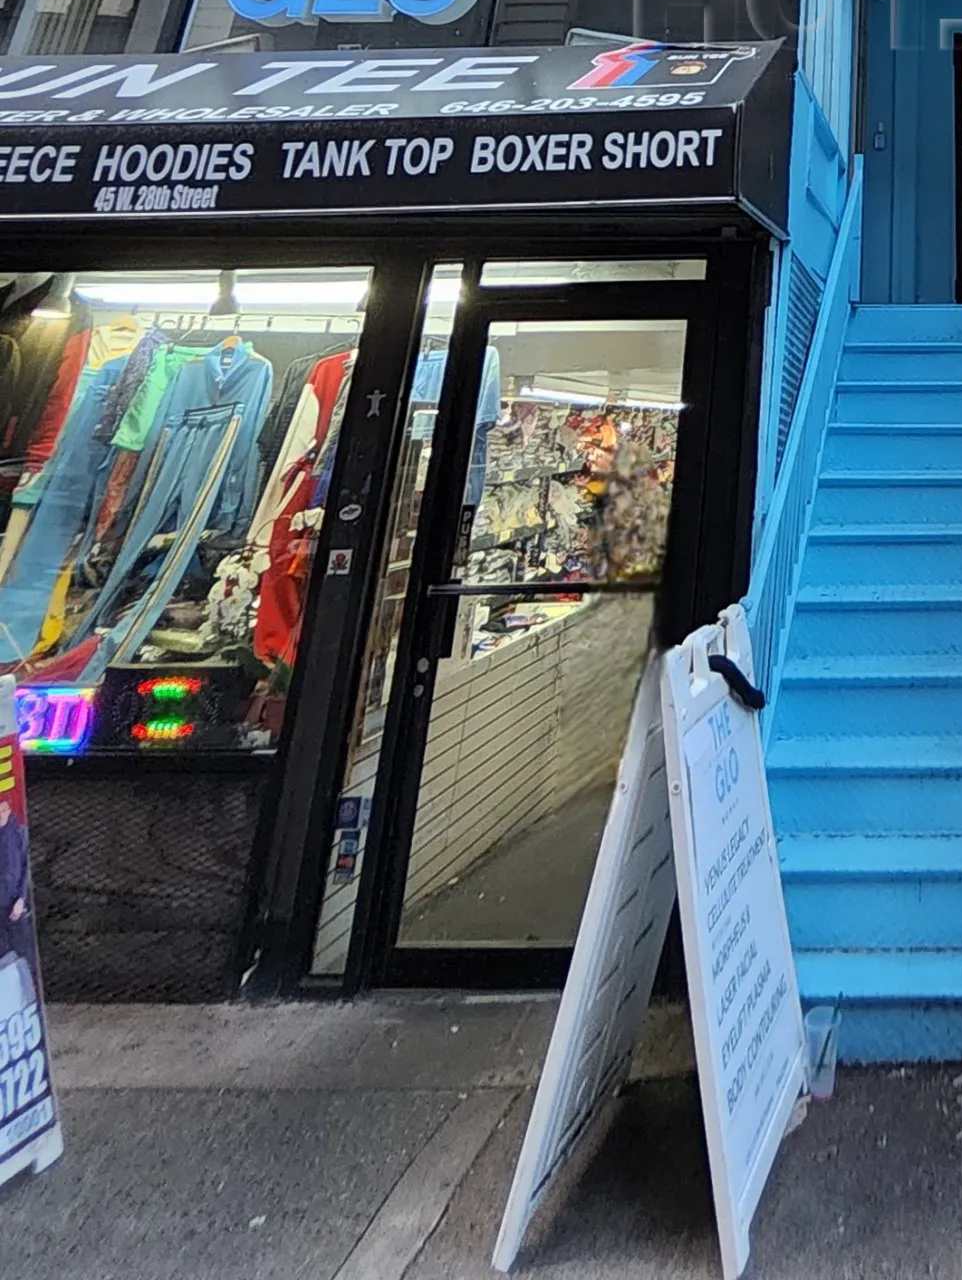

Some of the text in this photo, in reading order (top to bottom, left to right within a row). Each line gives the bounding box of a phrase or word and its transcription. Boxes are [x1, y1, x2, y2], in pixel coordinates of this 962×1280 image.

[232, 55, 540, 97] TEE
[107, 102, 401, 121] WHOLESALER
[440, 91, 706, 115] 646-203-4595
[92, 143, 255, 183] HOODIES
[281, 139, 377, 179] TANK
[383, 136, 455, 176] TOP
[470, 133, 594, 174] BOXER
[601, 129, 723, 169] SHORT
[93, 186, 117, 212] 45
[134, 185, 172, 211] 28th
[170, 183, 219, 210] Street
[707, 700, 732, 751] THE
[715, 746, 739, 804] GLO
